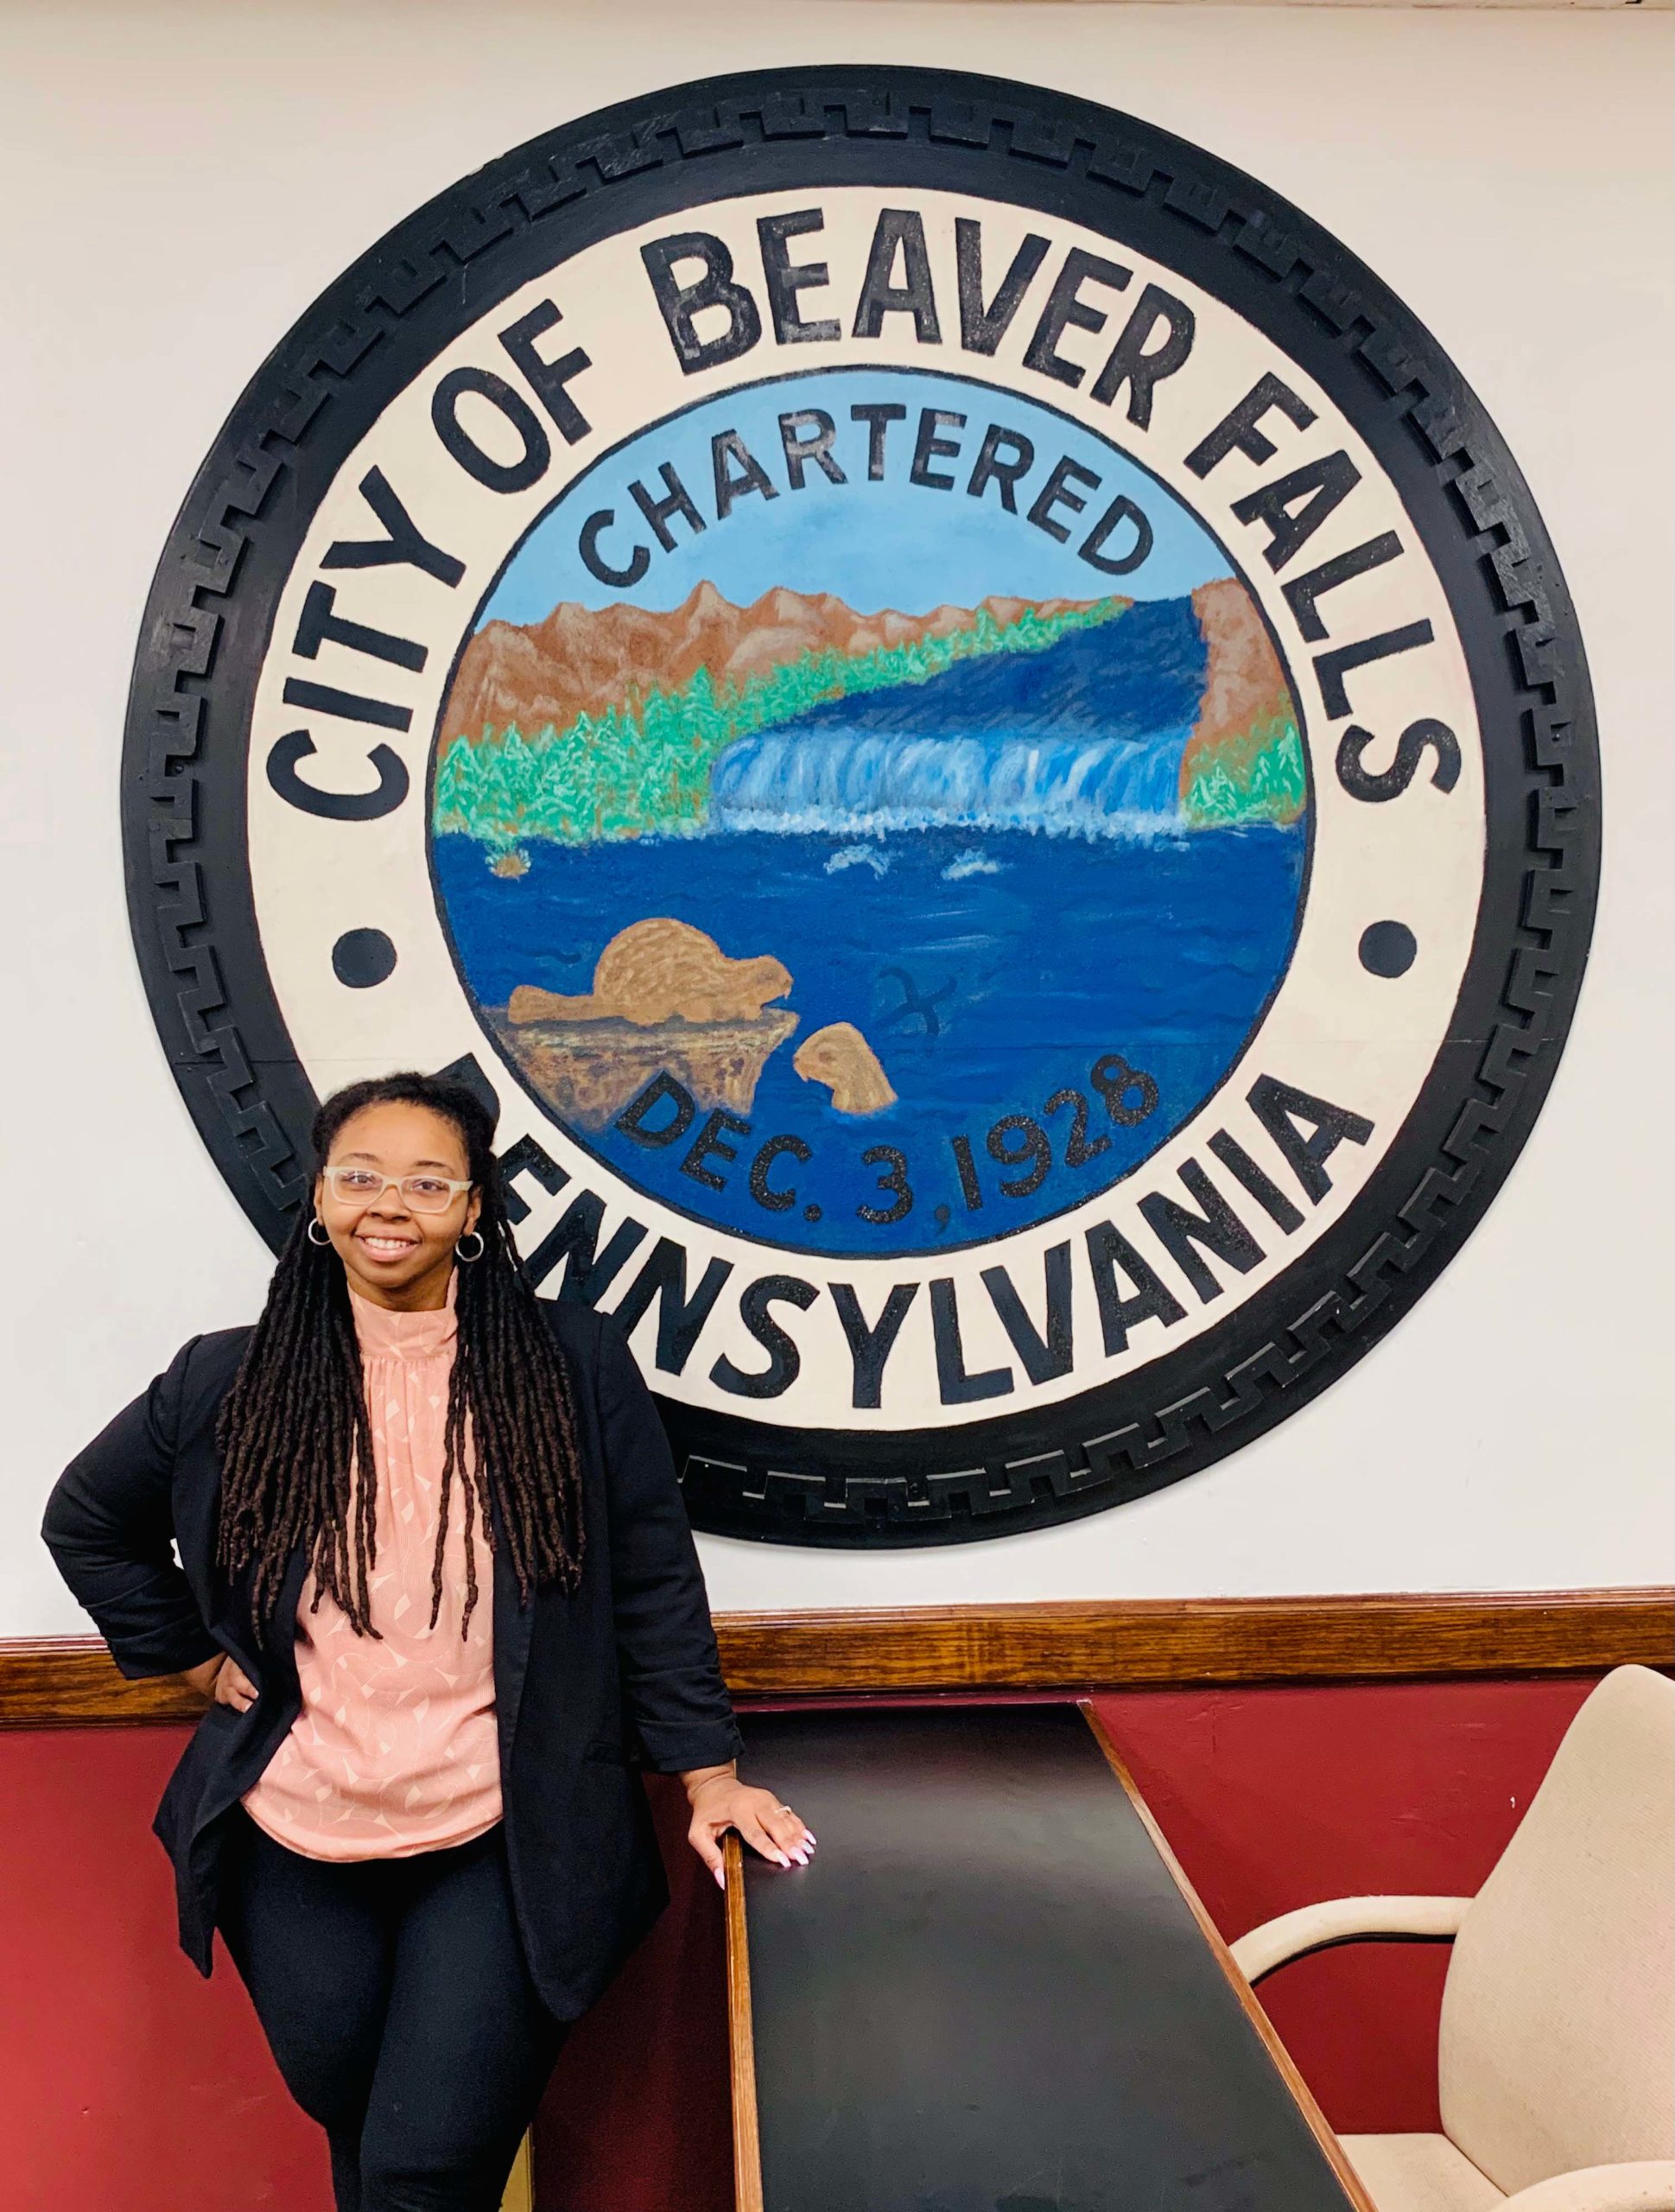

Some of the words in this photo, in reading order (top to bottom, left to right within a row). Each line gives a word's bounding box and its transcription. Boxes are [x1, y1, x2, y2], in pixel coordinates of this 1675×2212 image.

[266, 465, 466, 821] CITY
[431, 298, 593, 494] OF
[640, 207, 1196, 431] BEAVER
[1183, 372, 1462, 803] FALLS
[578, 404, 1154, 588] CHARTERED
[614, 1070, 822, 1222] DEC.
[951, 1053, 1159, 1211] 1928
